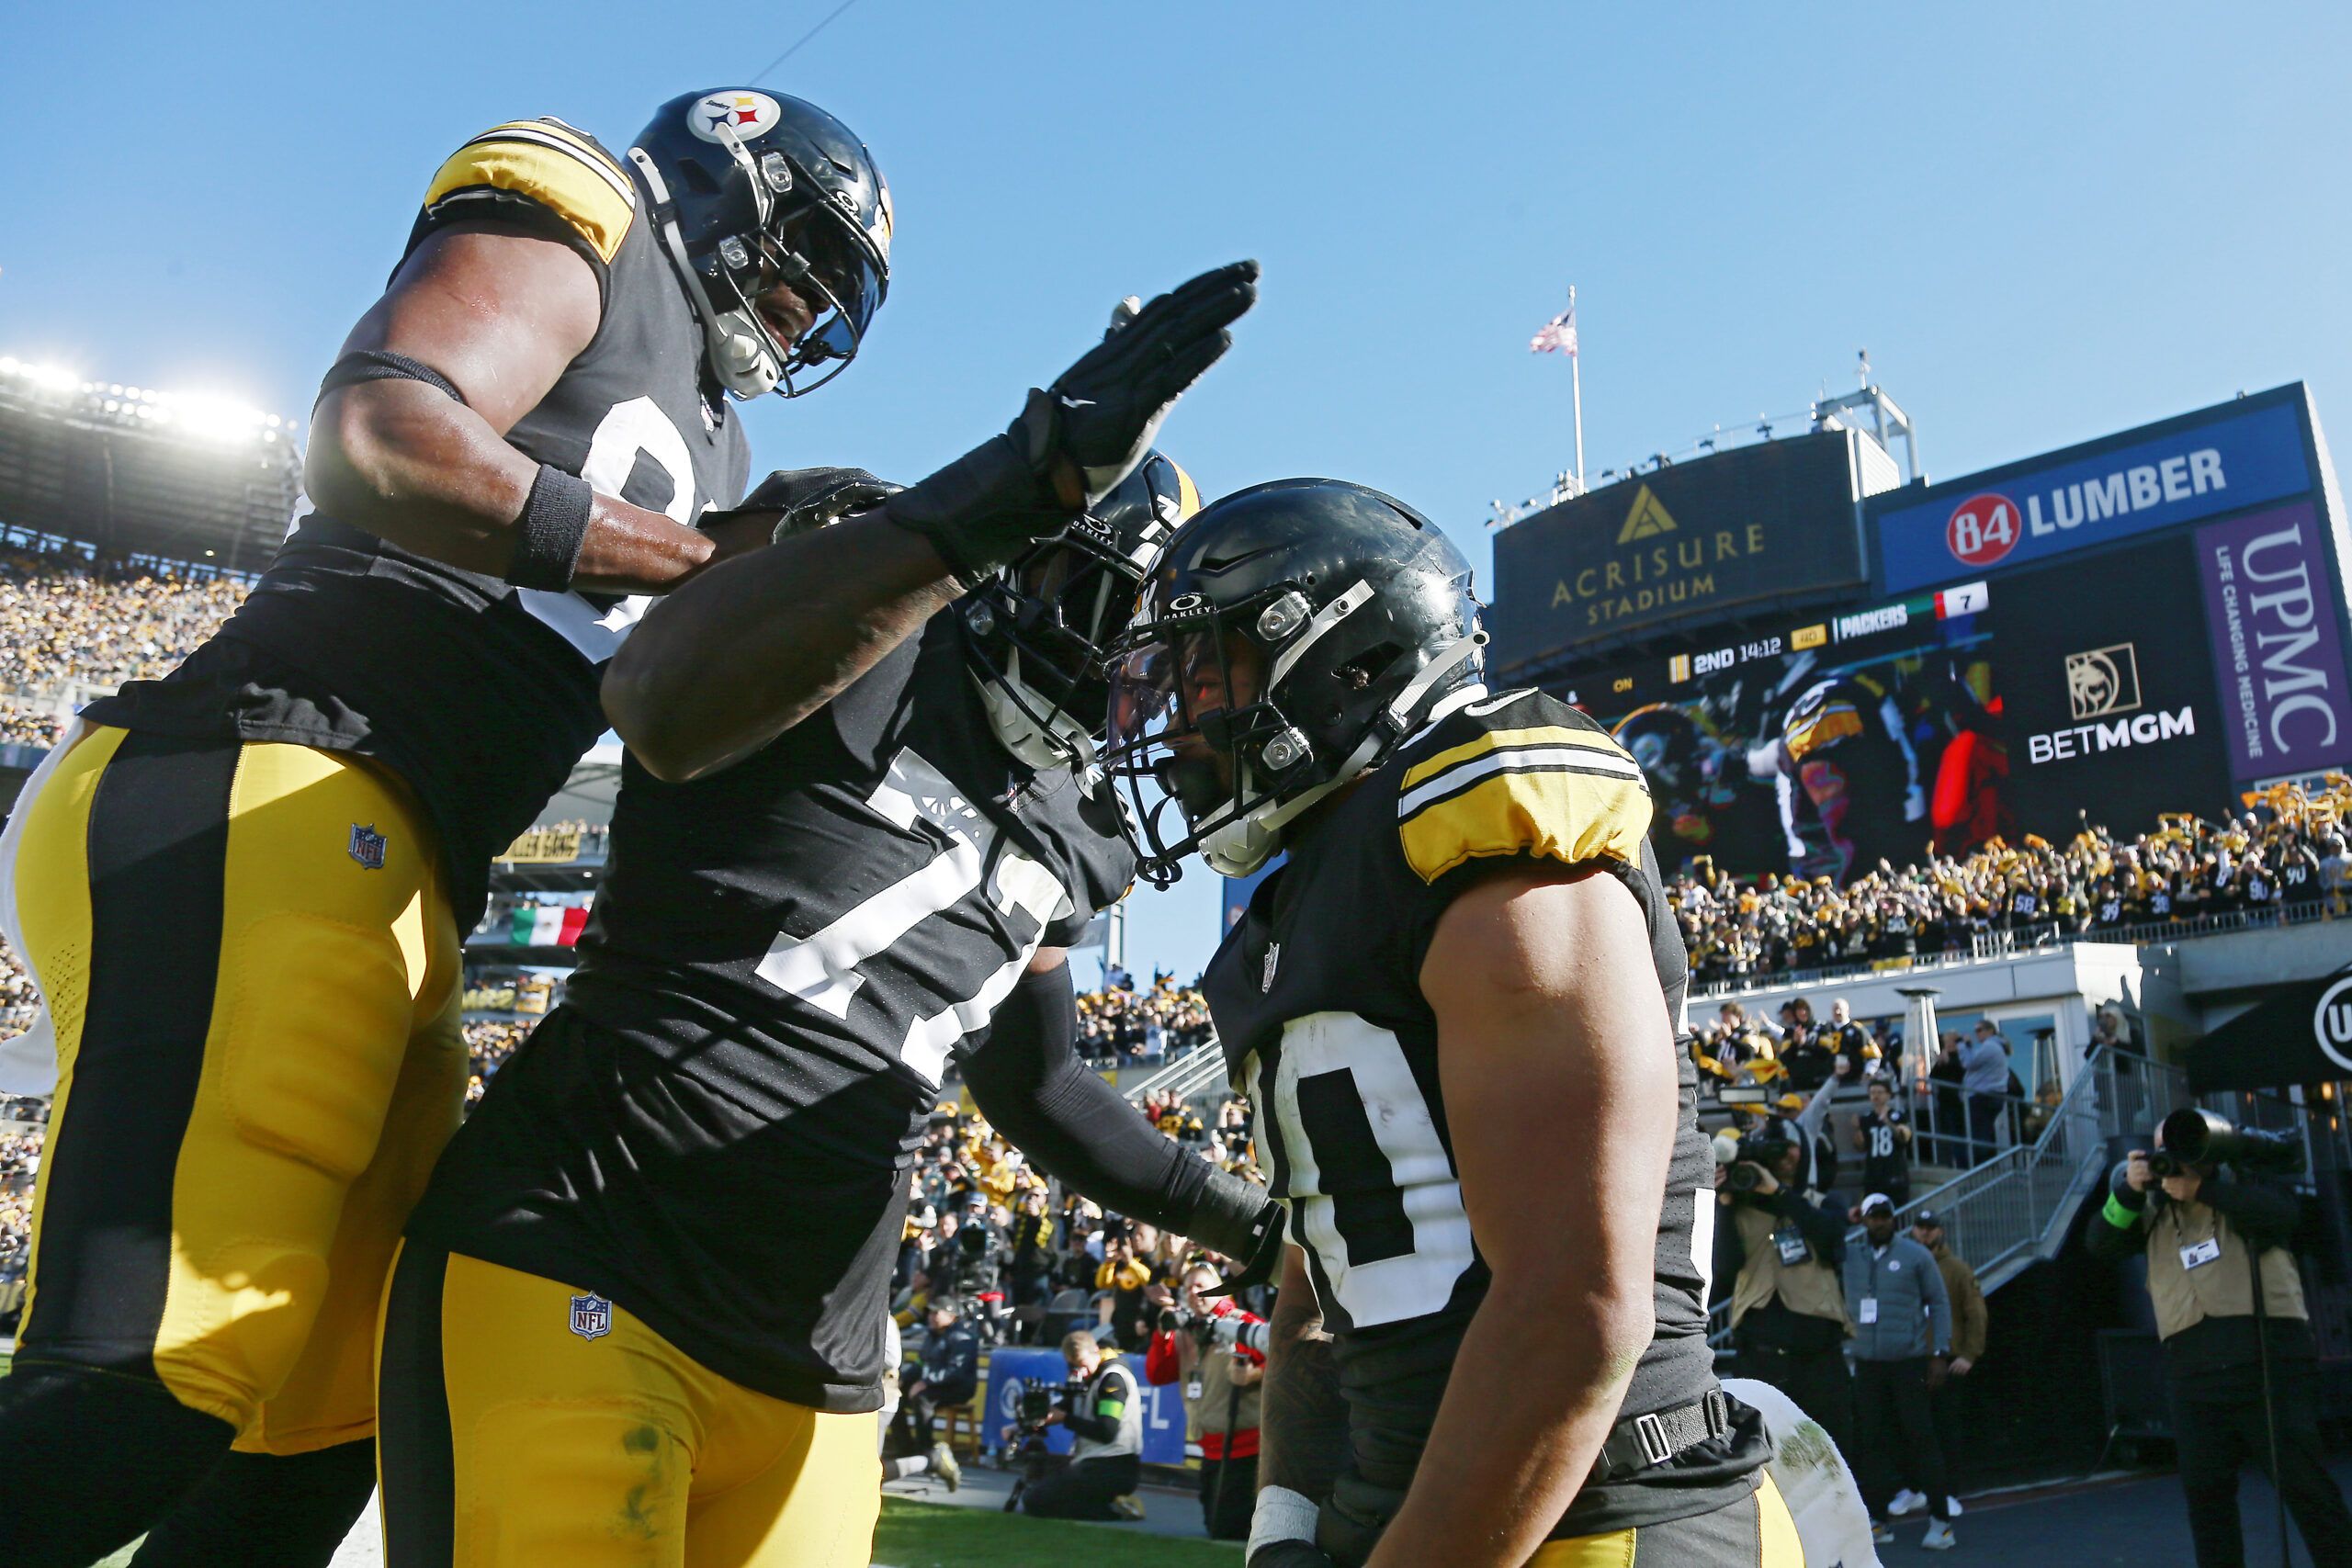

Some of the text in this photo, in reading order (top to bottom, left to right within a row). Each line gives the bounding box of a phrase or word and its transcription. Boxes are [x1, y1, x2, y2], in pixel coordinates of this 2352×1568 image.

[1955, 448, 2227, 555] 84 LUMBER
[1073, 519, 1114, 547] OAKLEY
[1551, 524, 1766, 610] ACRISURE
[1588, 573, 1716, 626] STADIUM
[1841, 604, 1907, 639] PACKERS
[1960, 594, 1972, 610] 7
[1693, 648, 1735, 674] 2ND
[1740, 636, 1781, 662] 14:12
[2216, 546, 2264, 759] LIFE CHANGING MEDICINE
[2242, 524, 2337, 755] UPMC
[2029, 706, 2196, 764] BETMGM
[1869, 1125, 1894, 1159] 18
[576, 1312, 605, 1331] NFL
